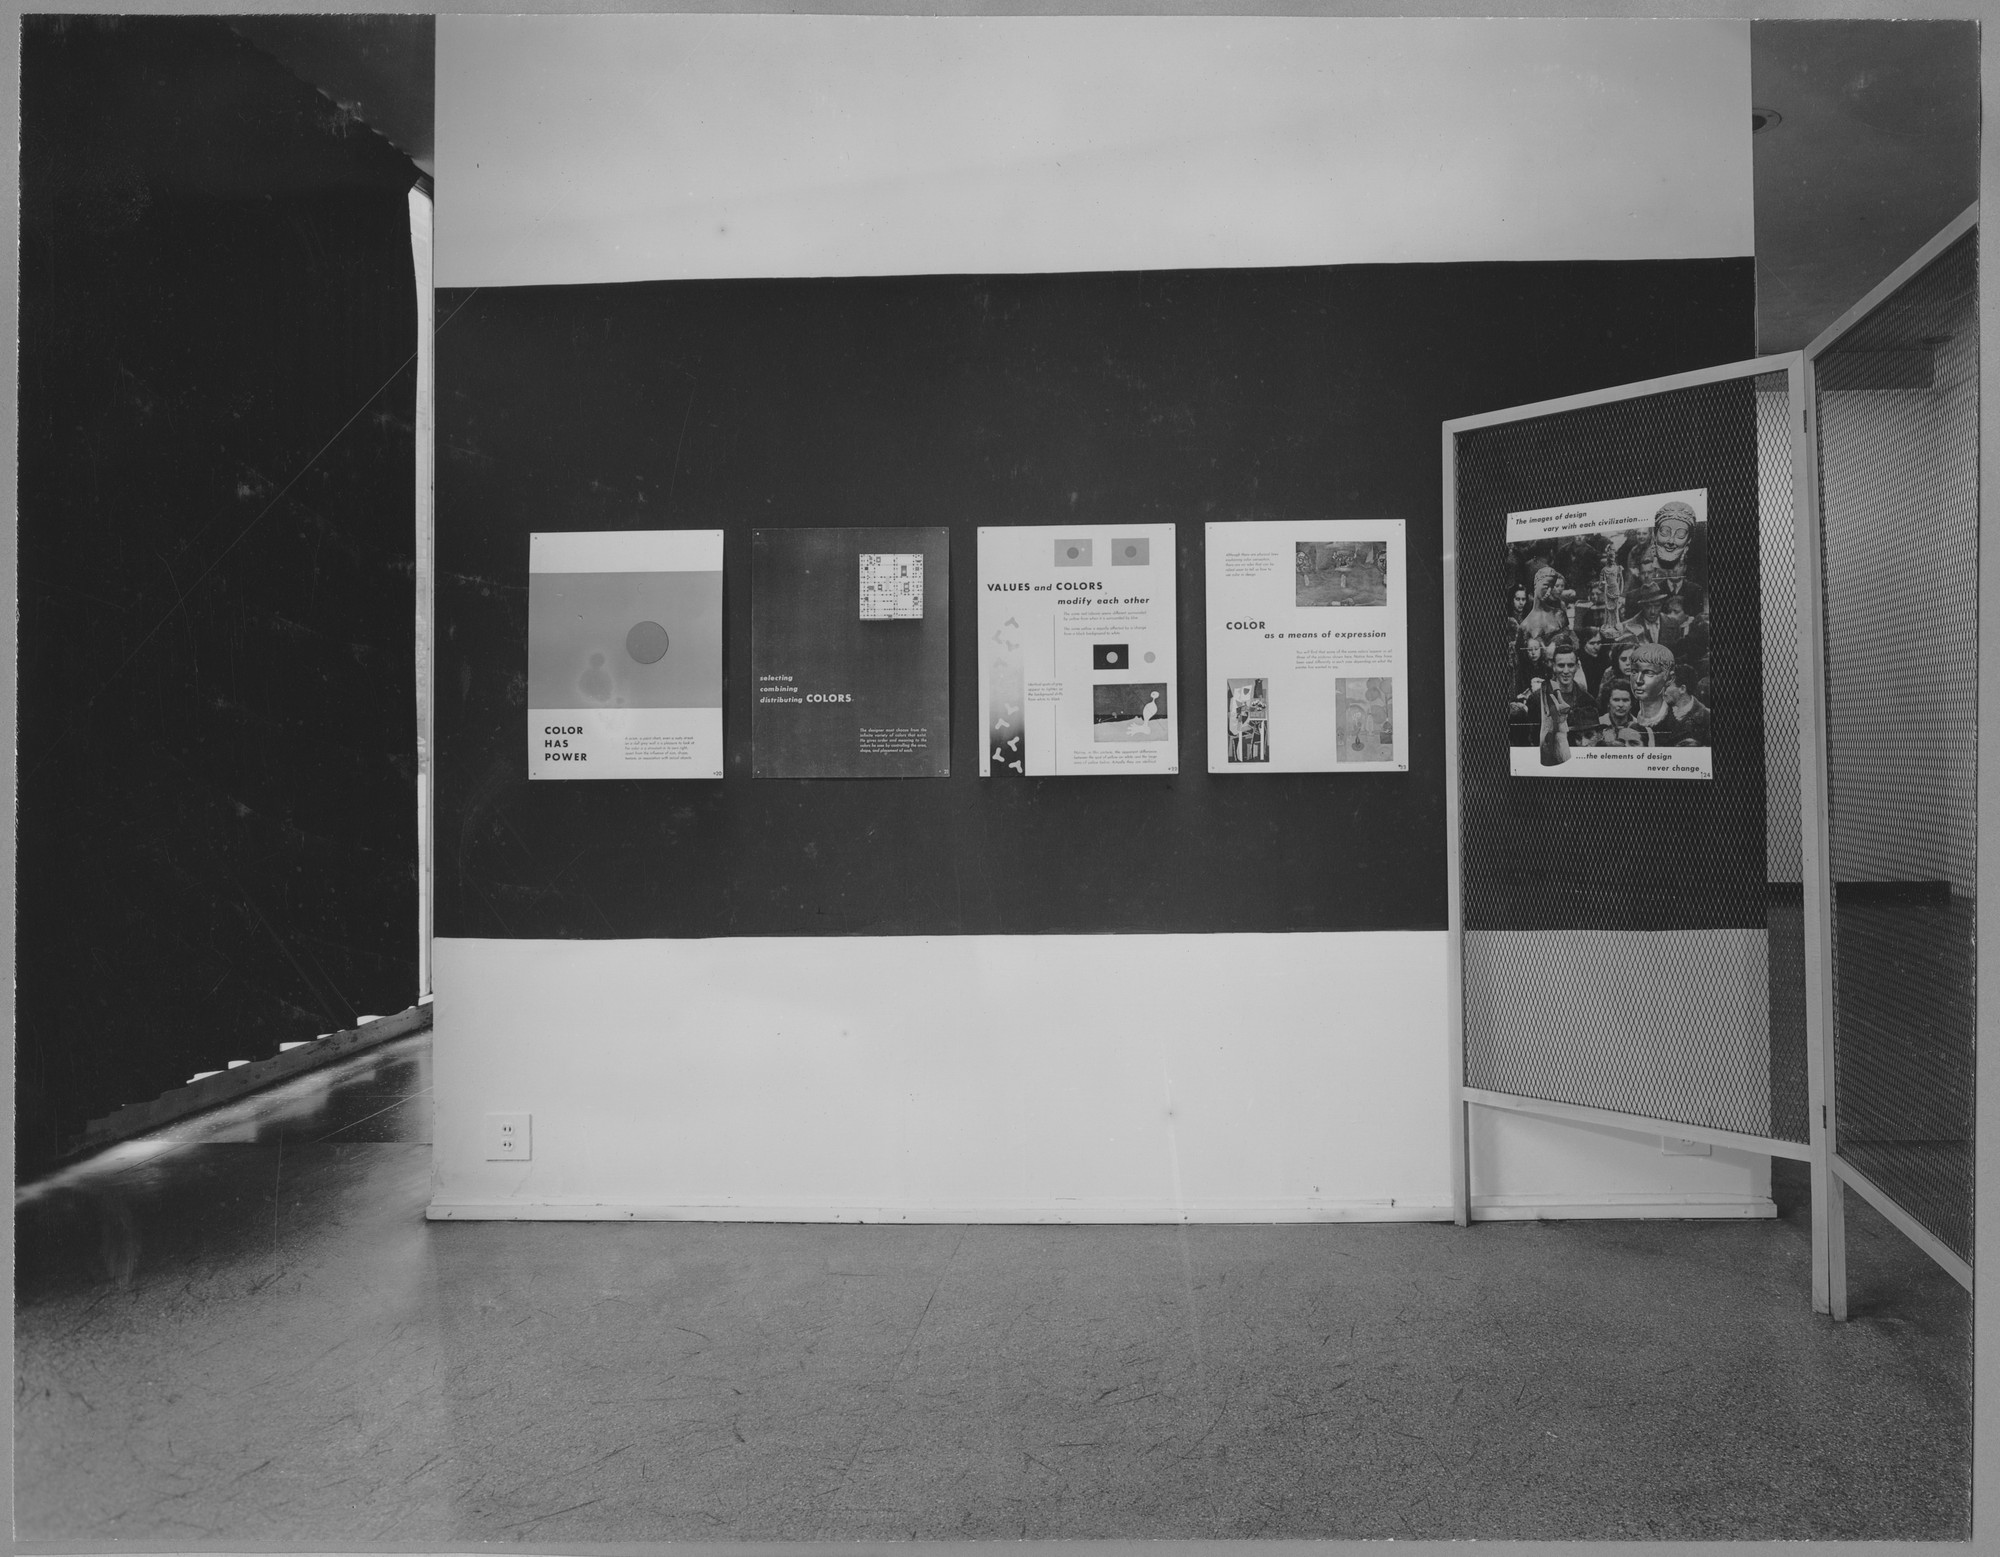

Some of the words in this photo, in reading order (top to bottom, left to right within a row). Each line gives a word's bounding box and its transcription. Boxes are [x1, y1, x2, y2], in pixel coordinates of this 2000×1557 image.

[1529, 516, 1552, 525] images
[1565, 511, 1587, 521] design
[988, 583, 1030, 591] VALUES
[1056, 582, 1103, 590] COLORS
[1058, 597, 1092, 606] modify
[1226, 622, 1265, 630] COLOR
[1335, 630, 1386, 639] expression
[545, 726, 583, 734] COLOR
[1647, 753, 1672, 761] design
[1672, 765, 1699, 773] change
